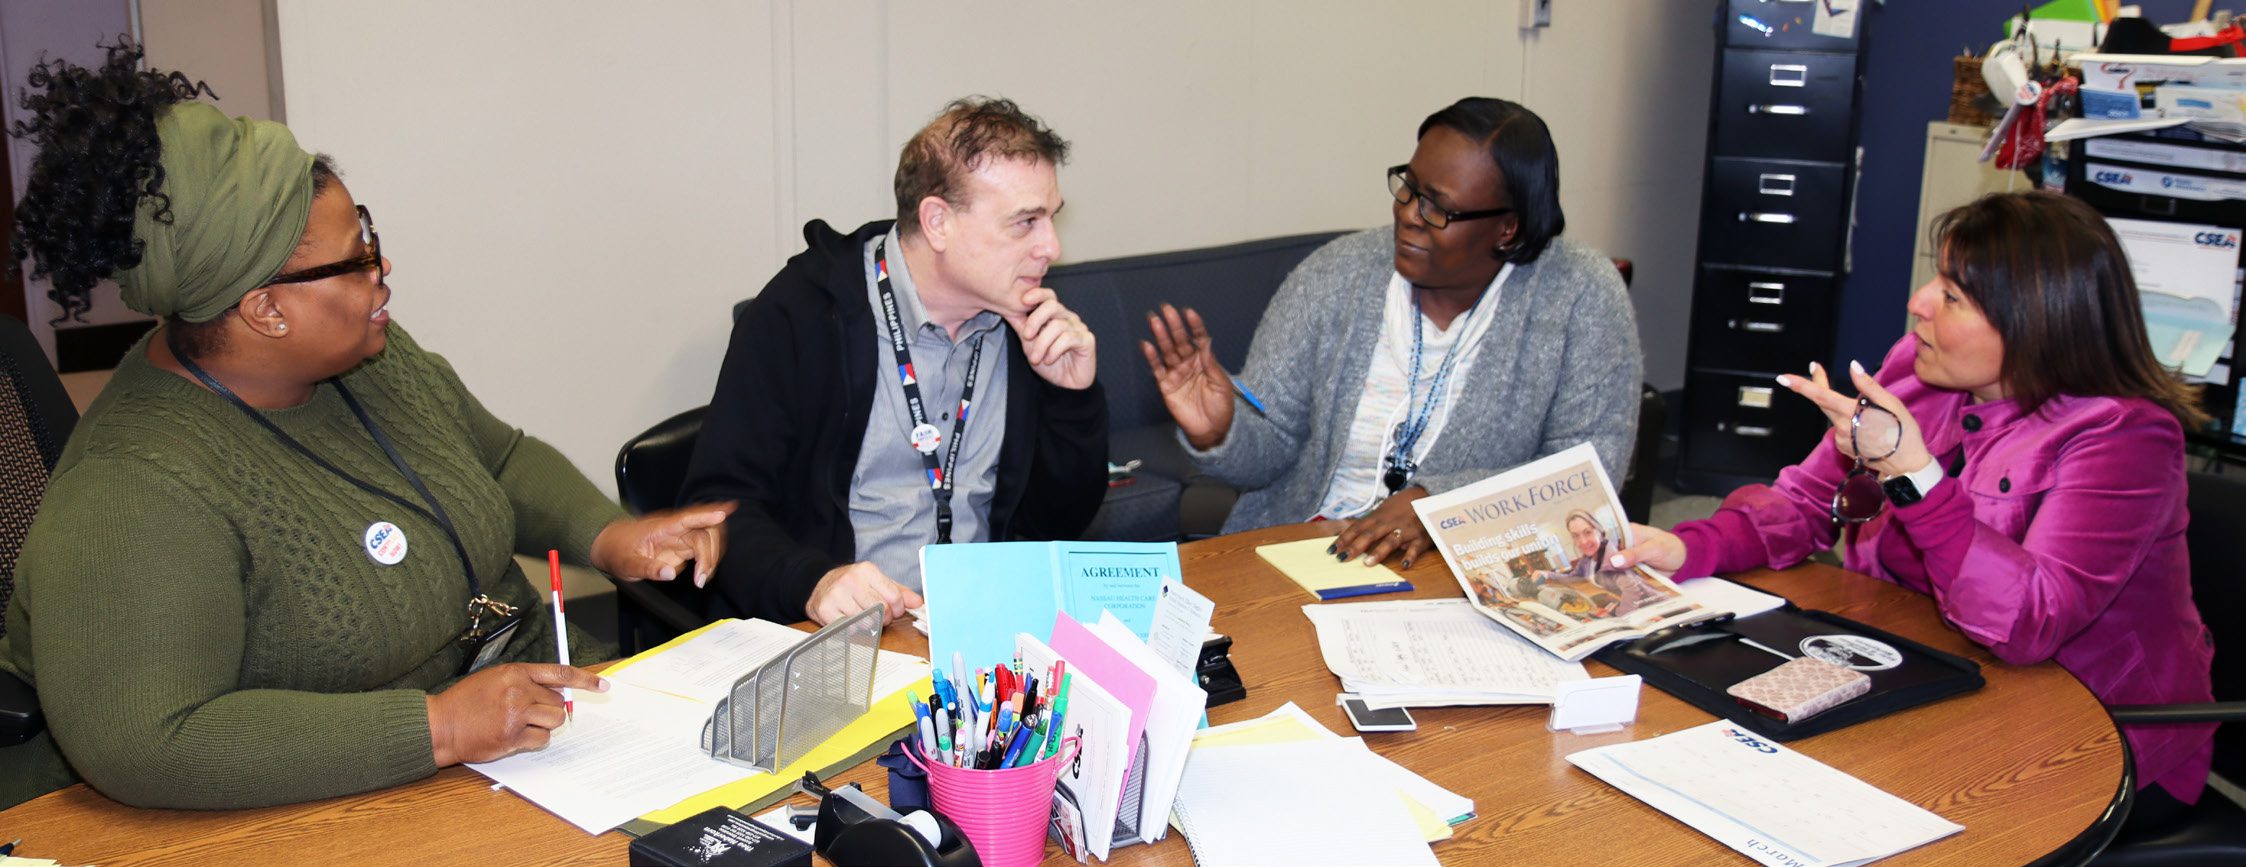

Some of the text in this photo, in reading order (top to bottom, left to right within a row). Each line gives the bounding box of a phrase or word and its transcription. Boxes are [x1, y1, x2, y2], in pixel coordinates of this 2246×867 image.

[2095, 171, 2134, 185] CSEA
[2194, 231, 2237, 249] CSEA
[883, 292, 905, 351] PHILIPPINES
[943, 432, 961, 490] PHILIPPINES
[1464, 494, 1528, 524] WORK
[1528, 469, 1592, 506] FORCE
[370, 524, 393, 549] CSEA
[1453, 523, 1538, 556] Building skills
[1463, 534, 1559, 570] builds our union
[1081, 567, 1160, 578] AGREEMENT
[1722, 729, 1778, 754] CSEA
[1747, 839, 1805, 867] March
